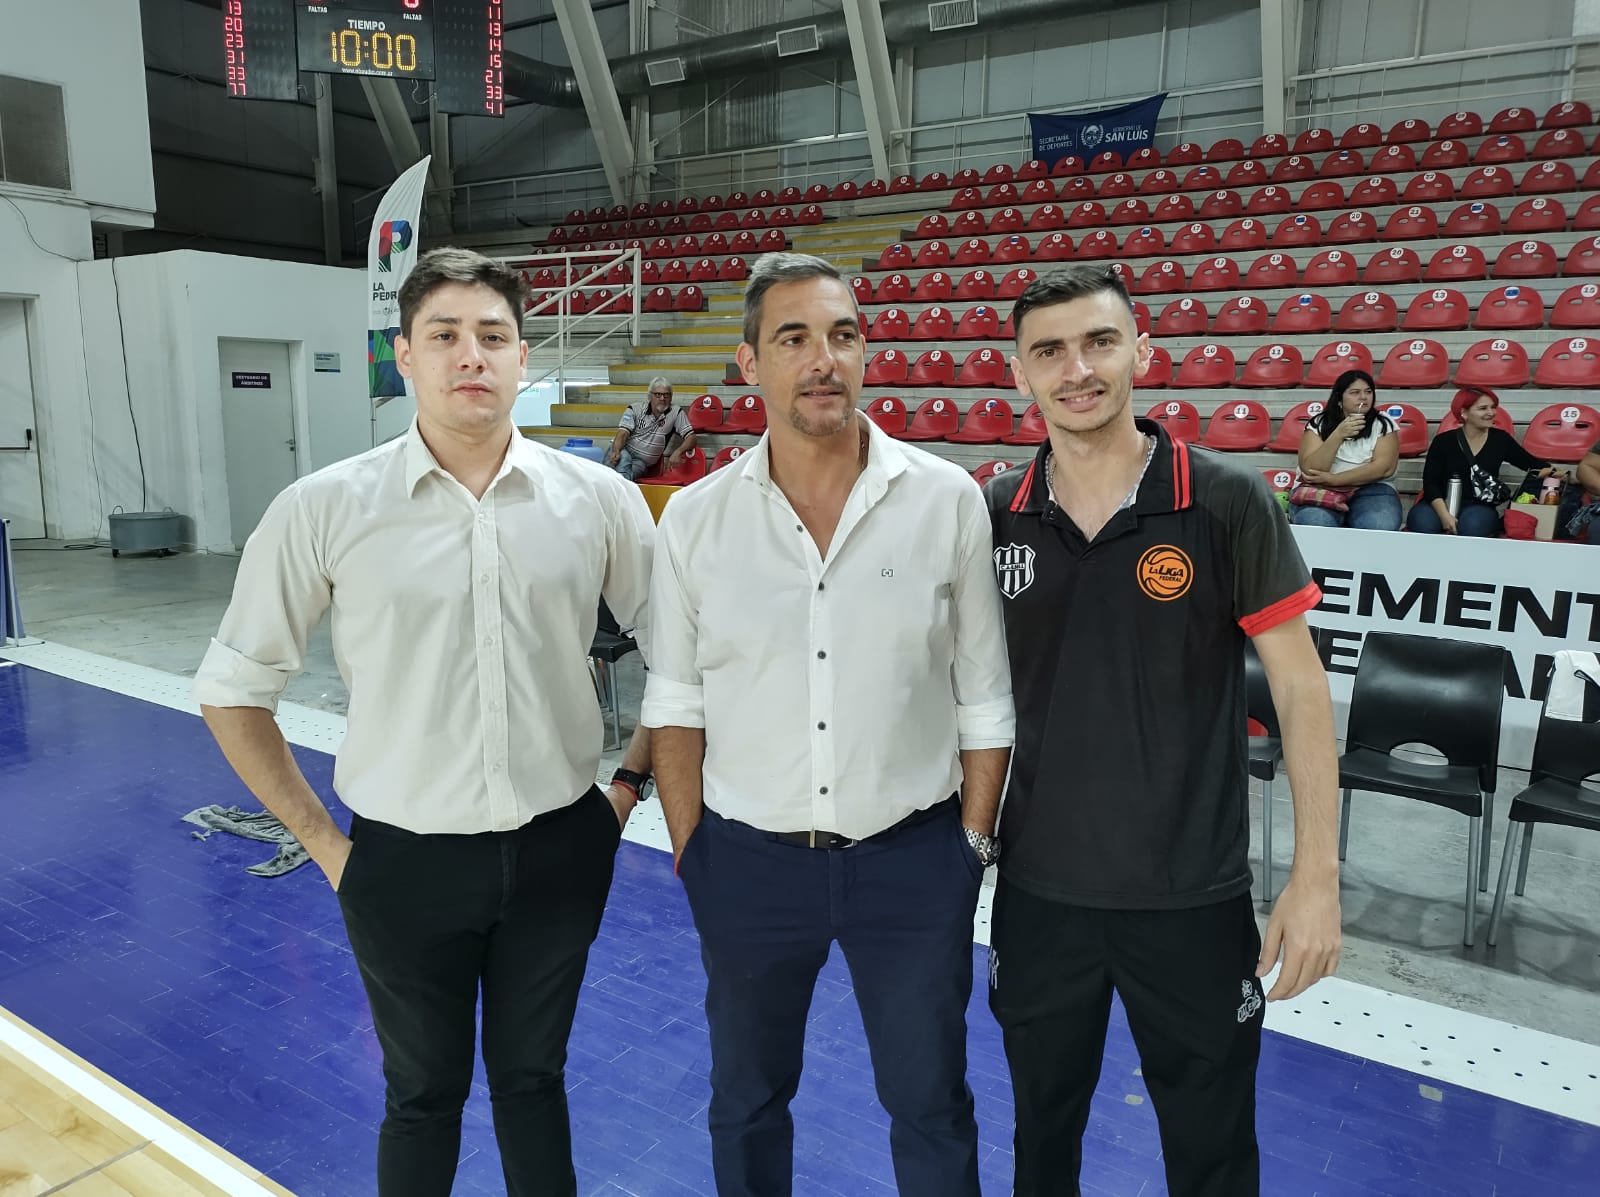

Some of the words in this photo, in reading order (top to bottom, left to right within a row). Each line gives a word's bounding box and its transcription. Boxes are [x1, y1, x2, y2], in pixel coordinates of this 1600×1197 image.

[228, 1, 242, 16] 13
[308, 5, 328, 13] FALTAS
[488, 6, 501, 20] 11
[402, 13, 422, 21] FALTAS
[225, 17, 243, 32] 20
[347, 19, 386, 31] TIEMPO
[489, 22, 502, 37] 13
[226, 34, 244, 48] 23
[489, 38, 502, 52] 14
[227, 50, 245, 64] 31
[330, 29, 416, 71] 10:00
[490, 54, 502, 68] 15
[228, 66, 246, 81] 33
[485, 69, 502, 84] 21
[229, 82, 247, 96] 77
[486, 85, 502, 100] 33
[486, 101, 503, 116] 41
[1105, 131, 1125, 143] SAN
[1127, 129, 1149, 141] LUIS
[1038, 144, 1047, 152] DE
[1047, 140, 1073, 151] DEPORTES
[372, 282, 385, 292] LA
